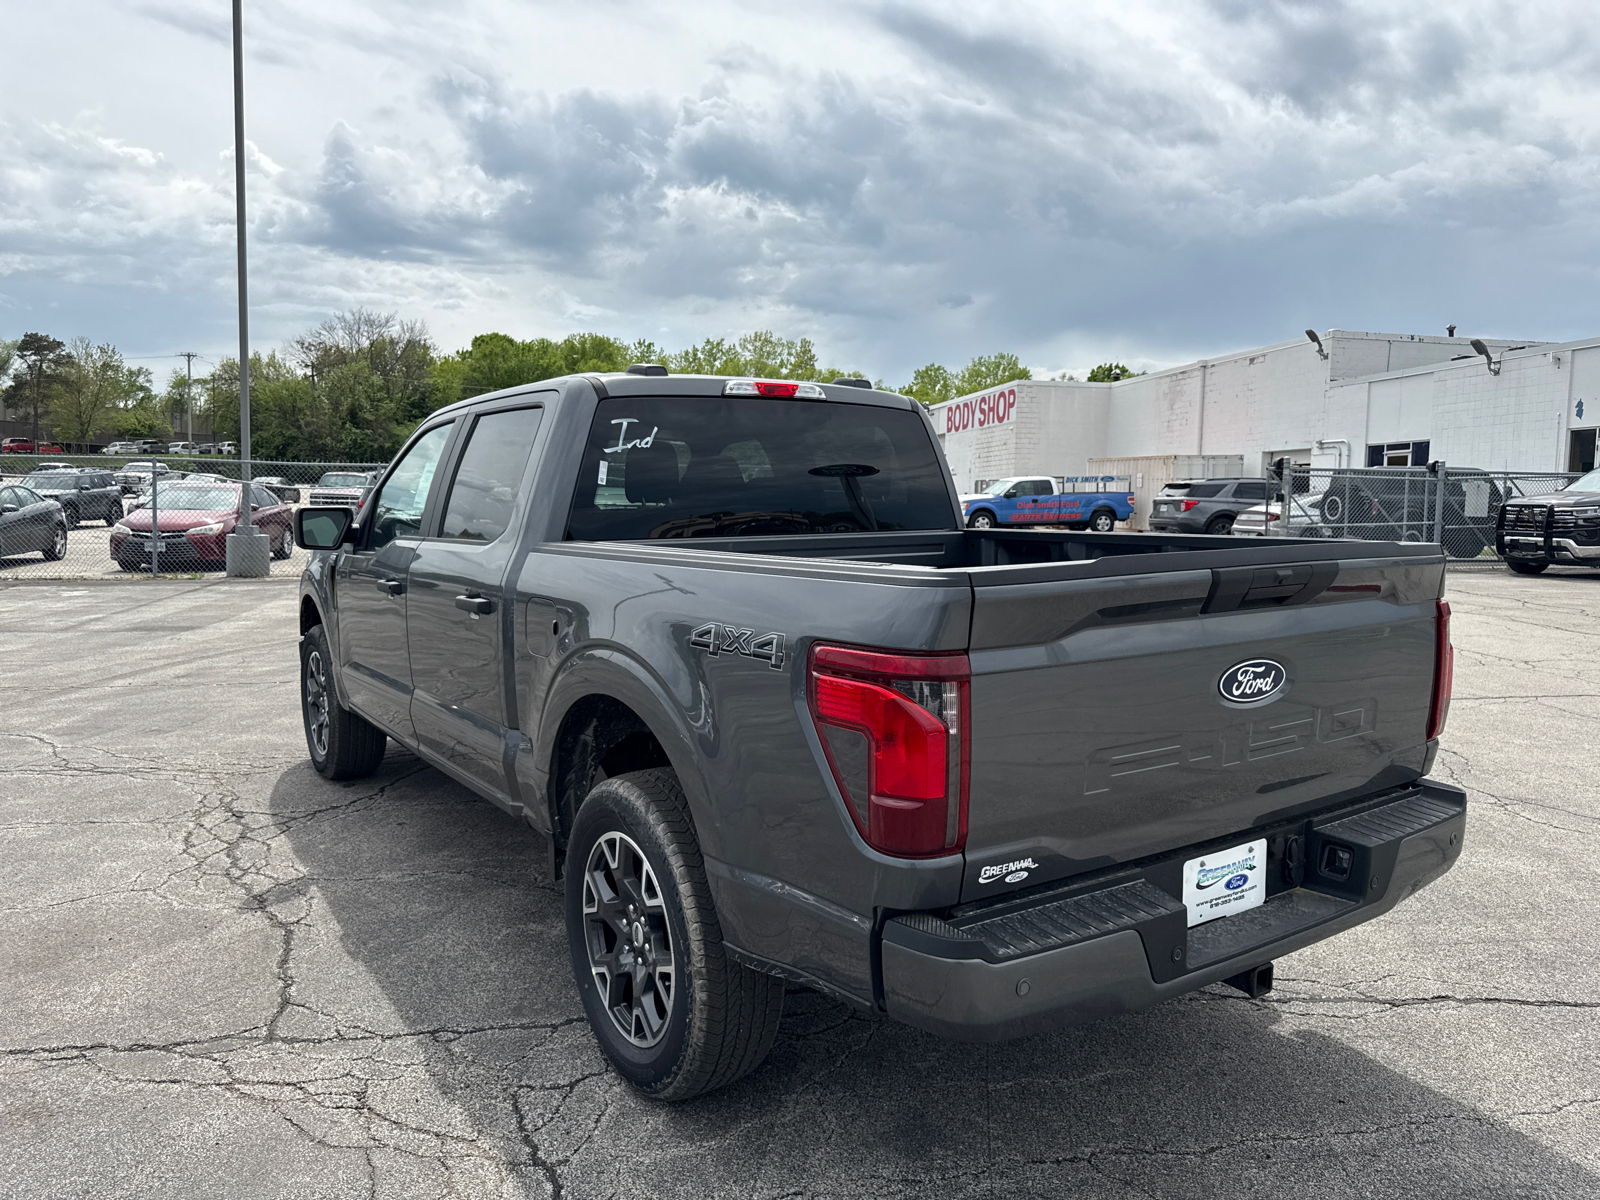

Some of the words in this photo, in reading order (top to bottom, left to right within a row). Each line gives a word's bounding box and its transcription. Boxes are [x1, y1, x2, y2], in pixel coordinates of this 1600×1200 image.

[603, 418, 658, 453] Ind
[1012, 513, 1042, 521] PARTS
[1042, 512, 1082, 520] EXPRESS
[1017, 501, 1034, 509] Dick
[1036, 500, 1060, 508] Smith
[1061, 500, 1079, 508] Ford
[1232, 666, 1275, 696] Ford
[1197, 855, 1256, 884] GREENWAY
